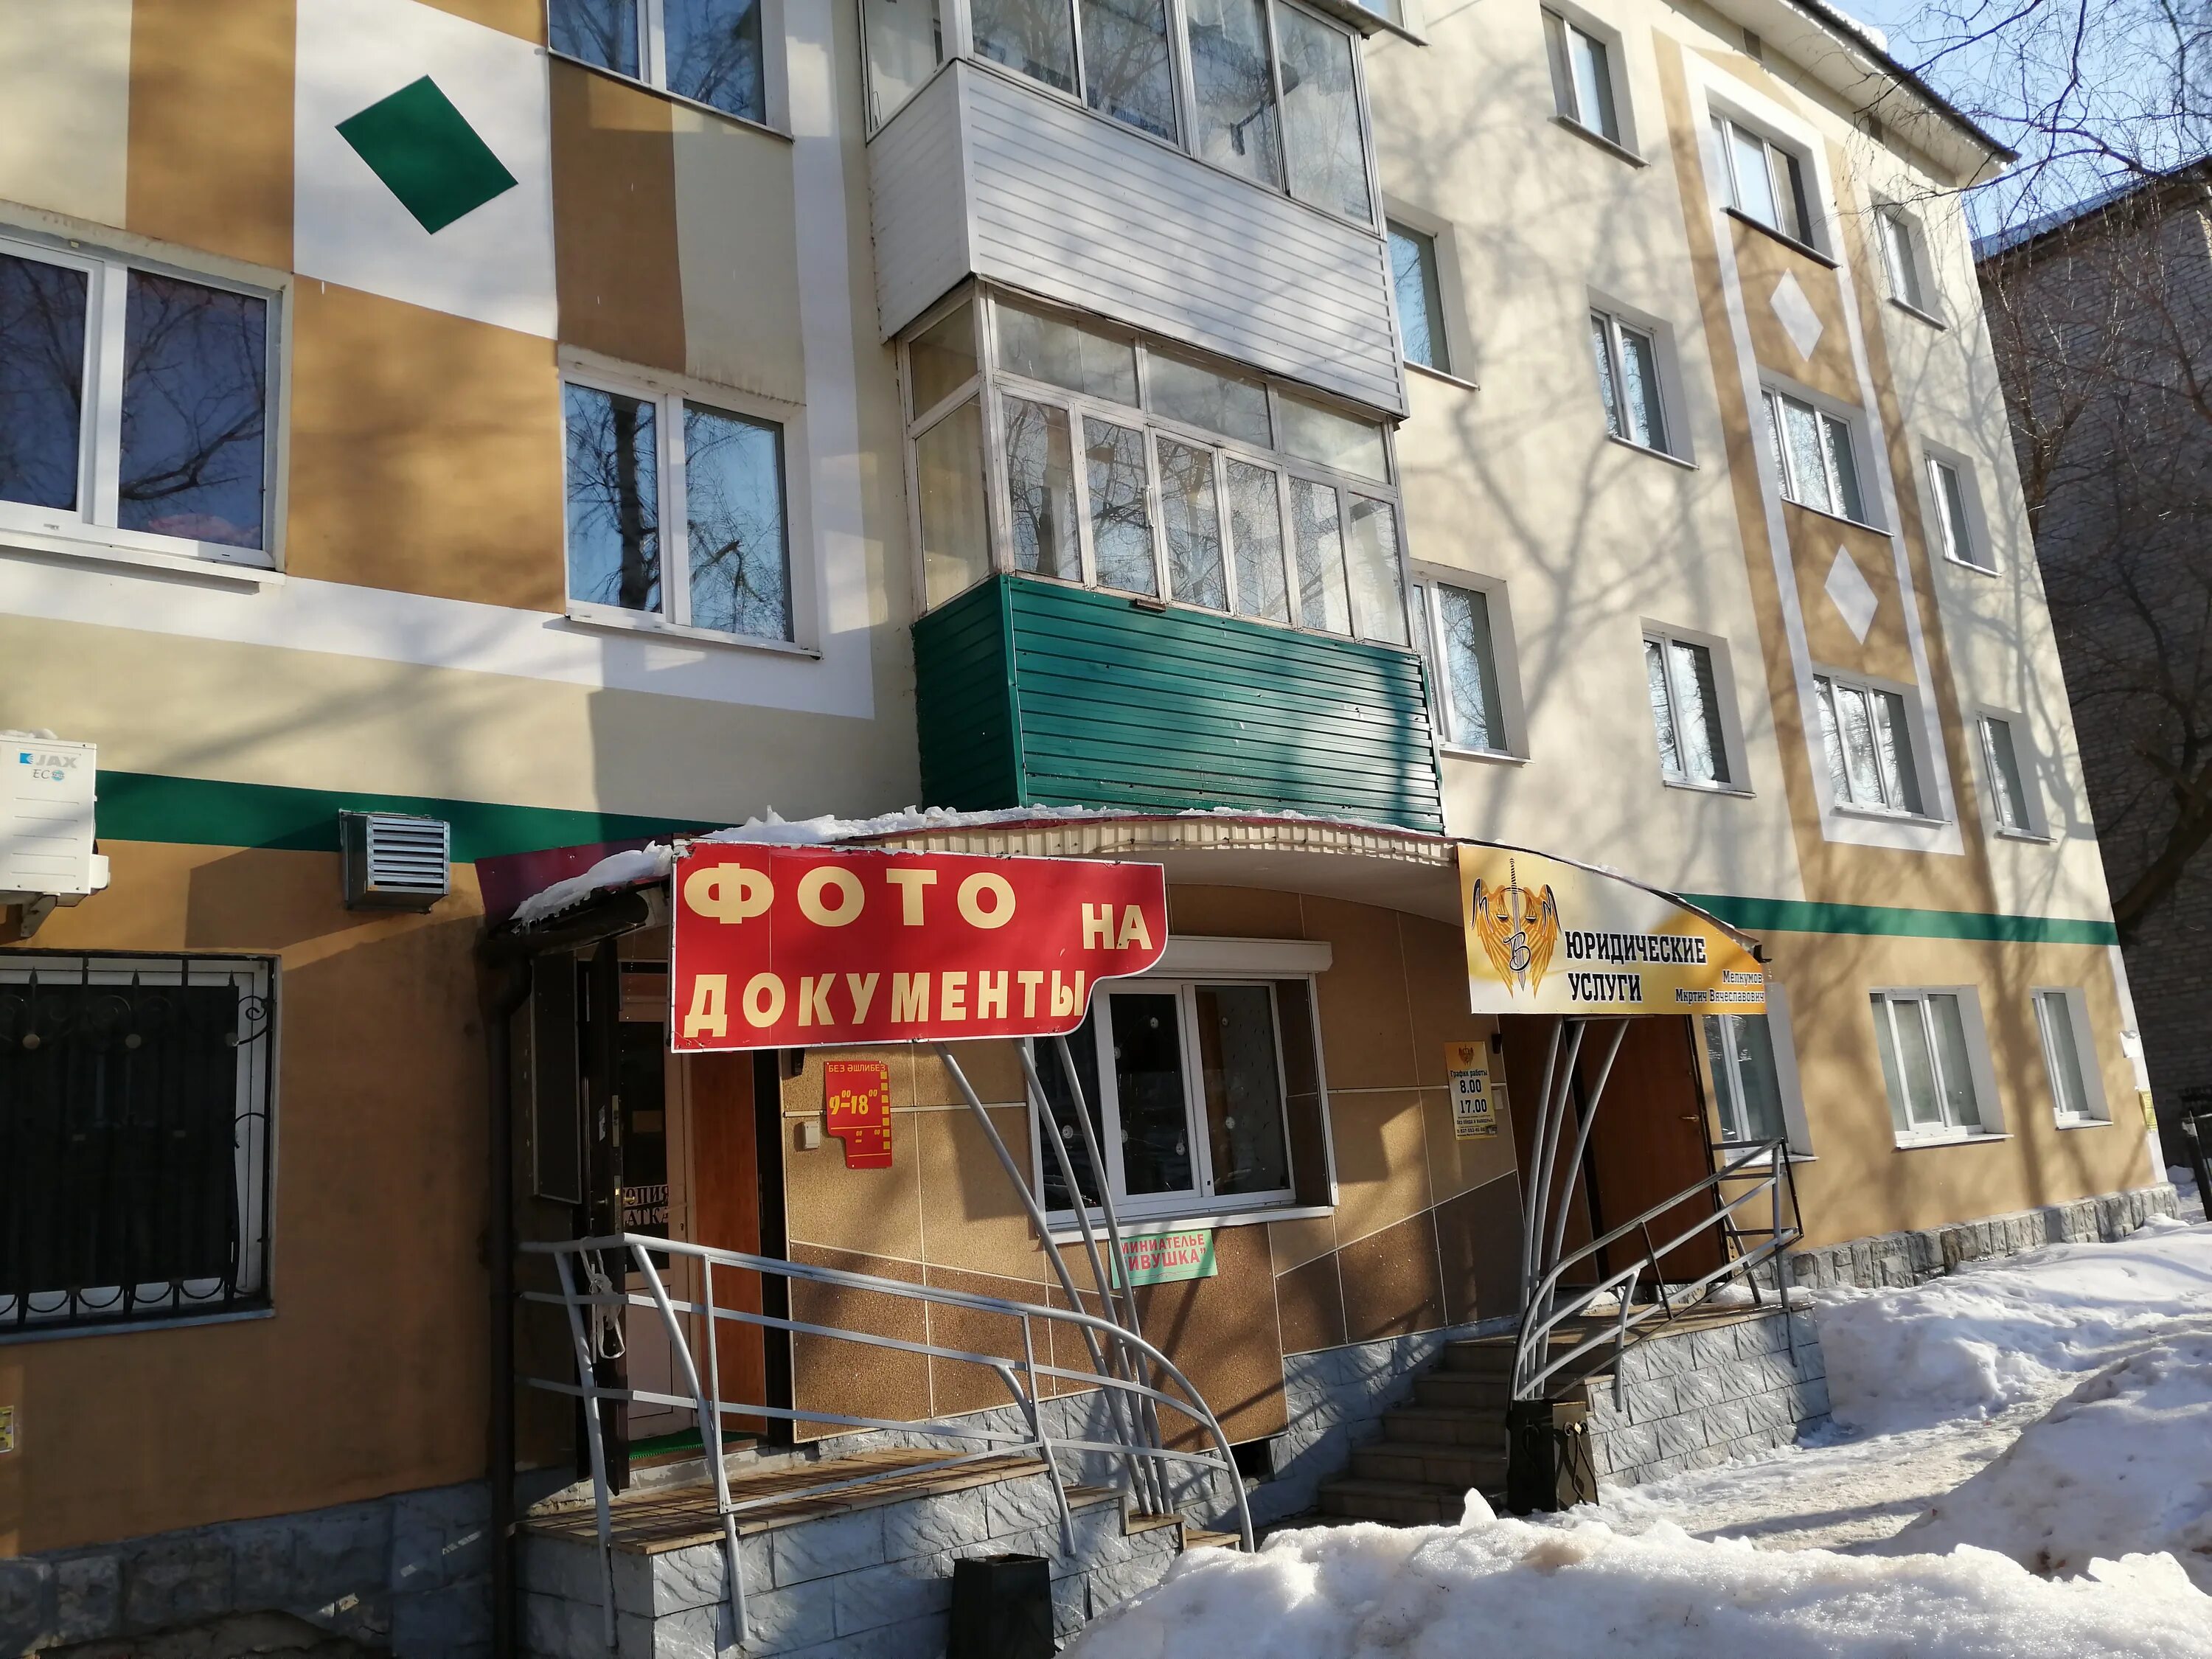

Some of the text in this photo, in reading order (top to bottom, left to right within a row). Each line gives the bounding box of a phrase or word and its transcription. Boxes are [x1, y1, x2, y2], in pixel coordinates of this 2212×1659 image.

[36, 754, 77, 768] JAX
[684, 862, 1153, 950] ФОТО НА
[1565, 931, 1707, 965] ЮРИДИЧЕСКИЕ
[1722, 970, 1762, 986] Мелкумов
[1568, 973, 1642, 1001] УСЛУГИ
[683, 970, 1085, 1037] ДОКУМЕНТЫ
[1675, 988, 1764, 1005] Мкртич Вячеславович
[828, 1065, 845, 1073] БЕЗ
[1470, 1069, 1488, 1078] работы
[1460, 1079, 1482, 1093] 8.00
[1460, 1099, 1487, 1114] 17.00
[1121, 1234, 1205, 1254] МИНИАТЕЛЬЕ
